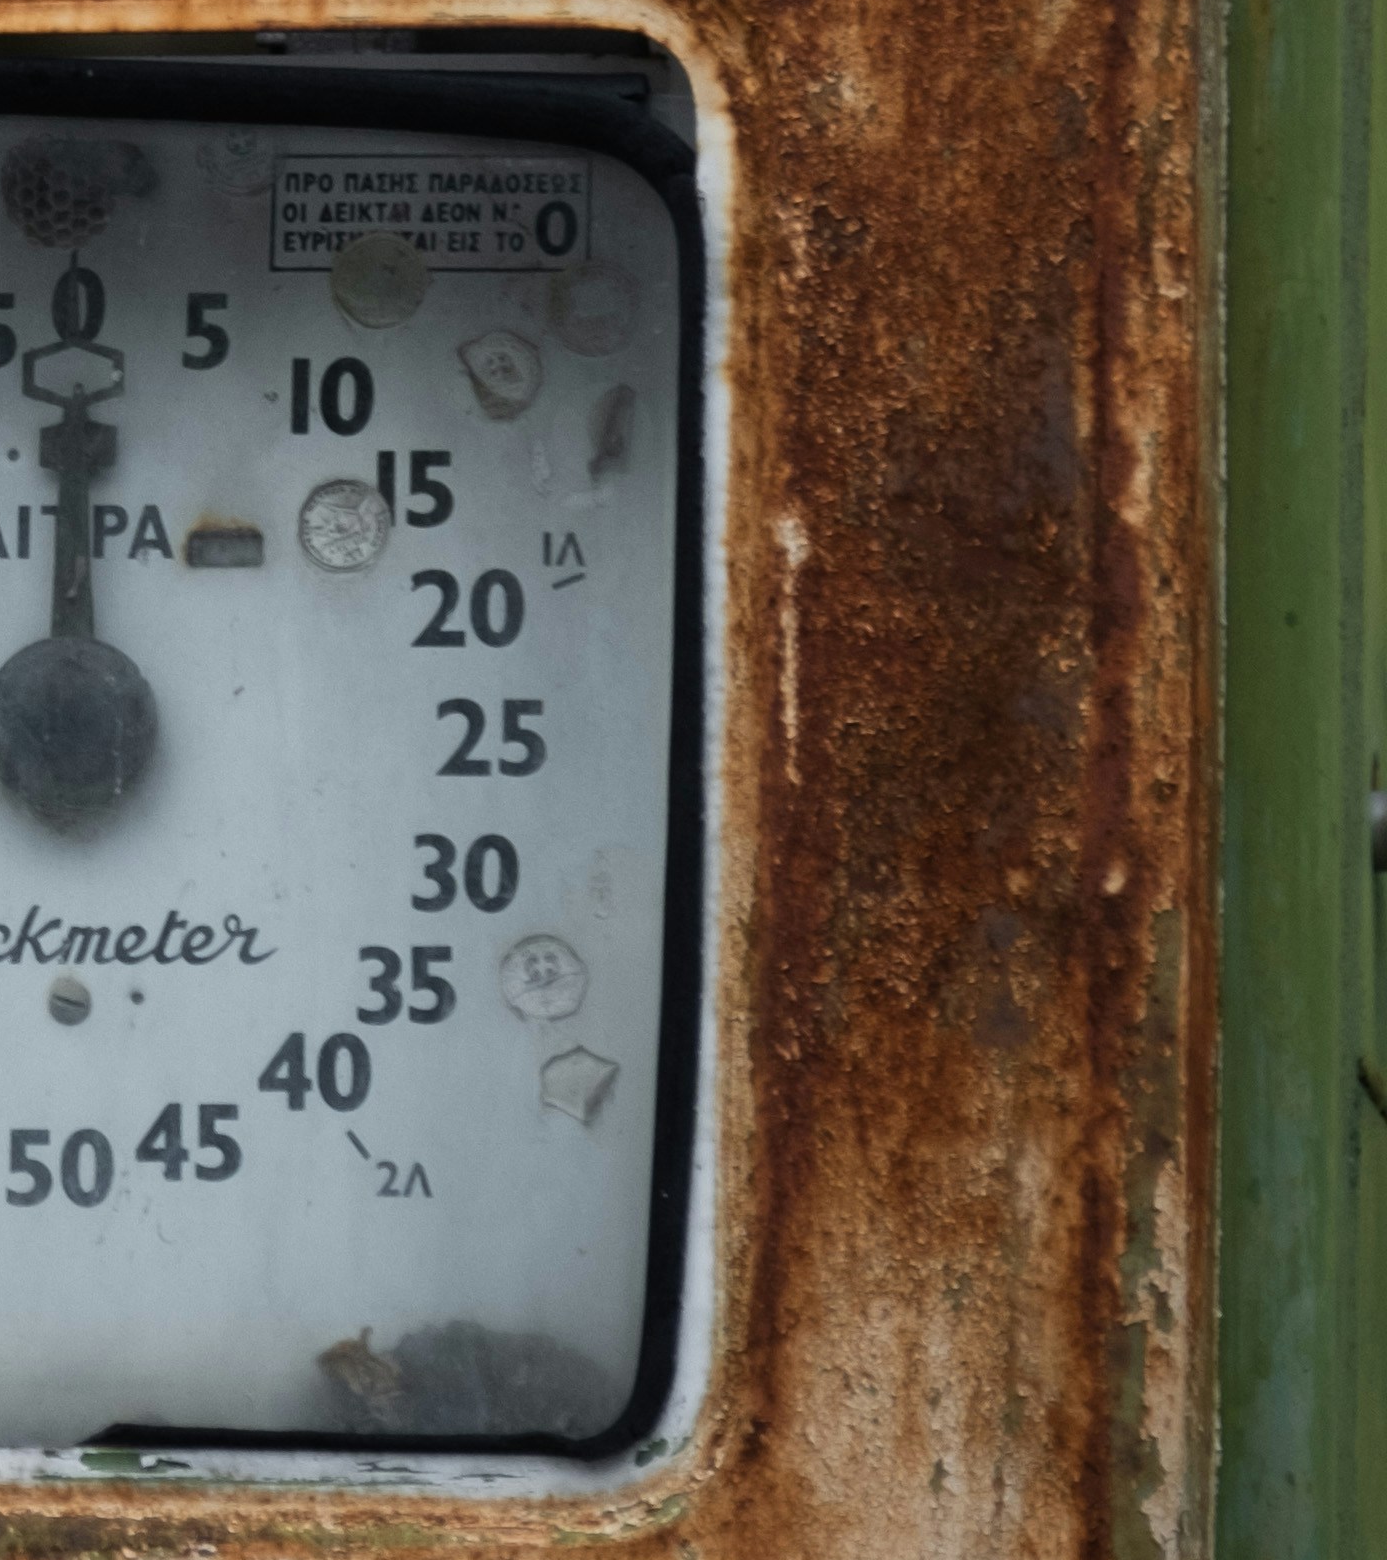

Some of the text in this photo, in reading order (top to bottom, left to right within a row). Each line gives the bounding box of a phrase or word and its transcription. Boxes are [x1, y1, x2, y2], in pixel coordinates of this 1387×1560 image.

[282, 202, 307, 223] ΟΙ
[420, 201, 481, 223] ΔΕΟΝ
[285, 172, 582, 194] ΠΡΟ ΠΑΣΗΣ ΠΑΡΑΔΟΣΕΩΣ
[446, 231, 481, 253] ΕΙΣ
[496, 231, 525, 253] ΤΟ
[51, 266, 106, 343] 0
[181, 291, 231, 370] 5
[291, 356, 375, 436] 10
[377, 449, 455, 529] 15
[411, 568, 526, 648] 20
[437, 698, 547, 777] 25
[412, 833, 519, 913] 30
[357, 945, 457, 1025] 35
[258, 1032, 372, 1112] 40
[6, 1128, 114, 1208] 50
[135, 1102, 242, 1181] 45
